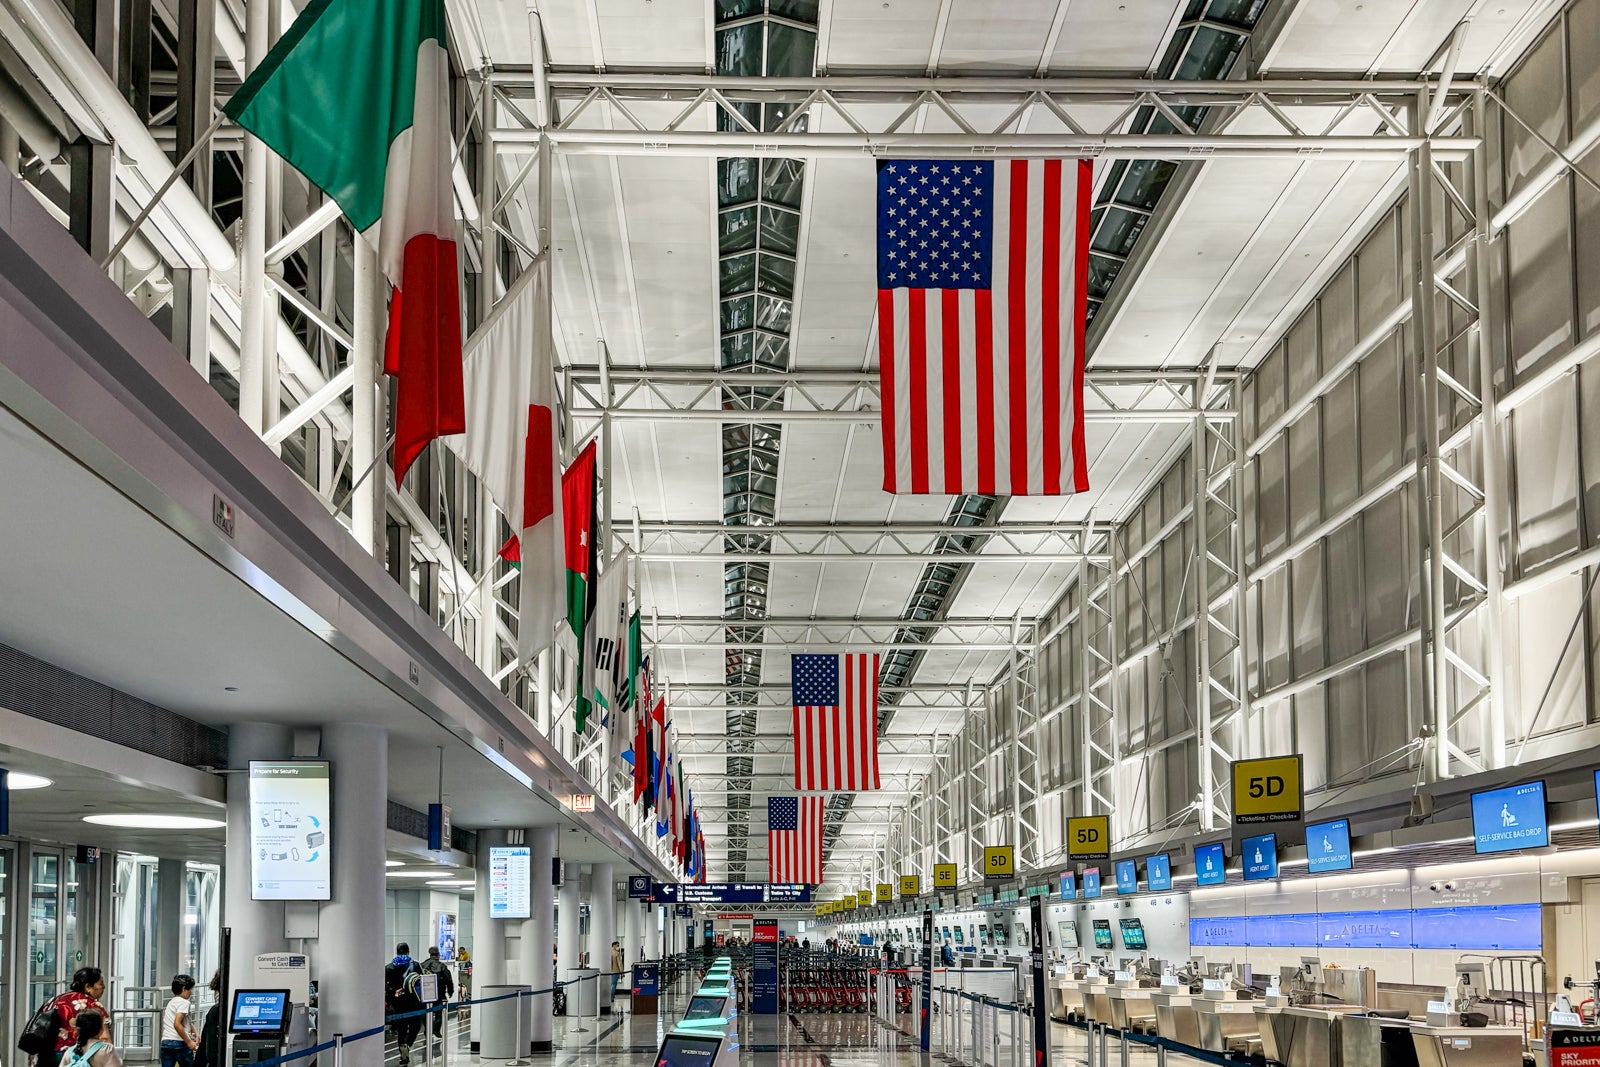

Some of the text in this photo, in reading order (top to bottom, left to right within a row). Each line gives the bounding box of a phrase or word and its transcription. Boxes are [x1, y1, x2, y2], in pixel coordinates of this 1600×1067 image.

[216, 511, 234, 535] ITALY
[1248, 776, 1285, 798] 5D
[575, 794, 592, 807] EXIT
[1077, 828, 1099, 843] 5D
[1479, 827, 1542, 843] SELF-SERVICE BAG DROP
[991, 855, 1007, 867] 5D
[939, 871, 951, 880] 5E
[904, 881, 914, 889] 5E
[1210, 927, 1228, 936] DELTA
[1351, 924, 1381, 935] DELTA
